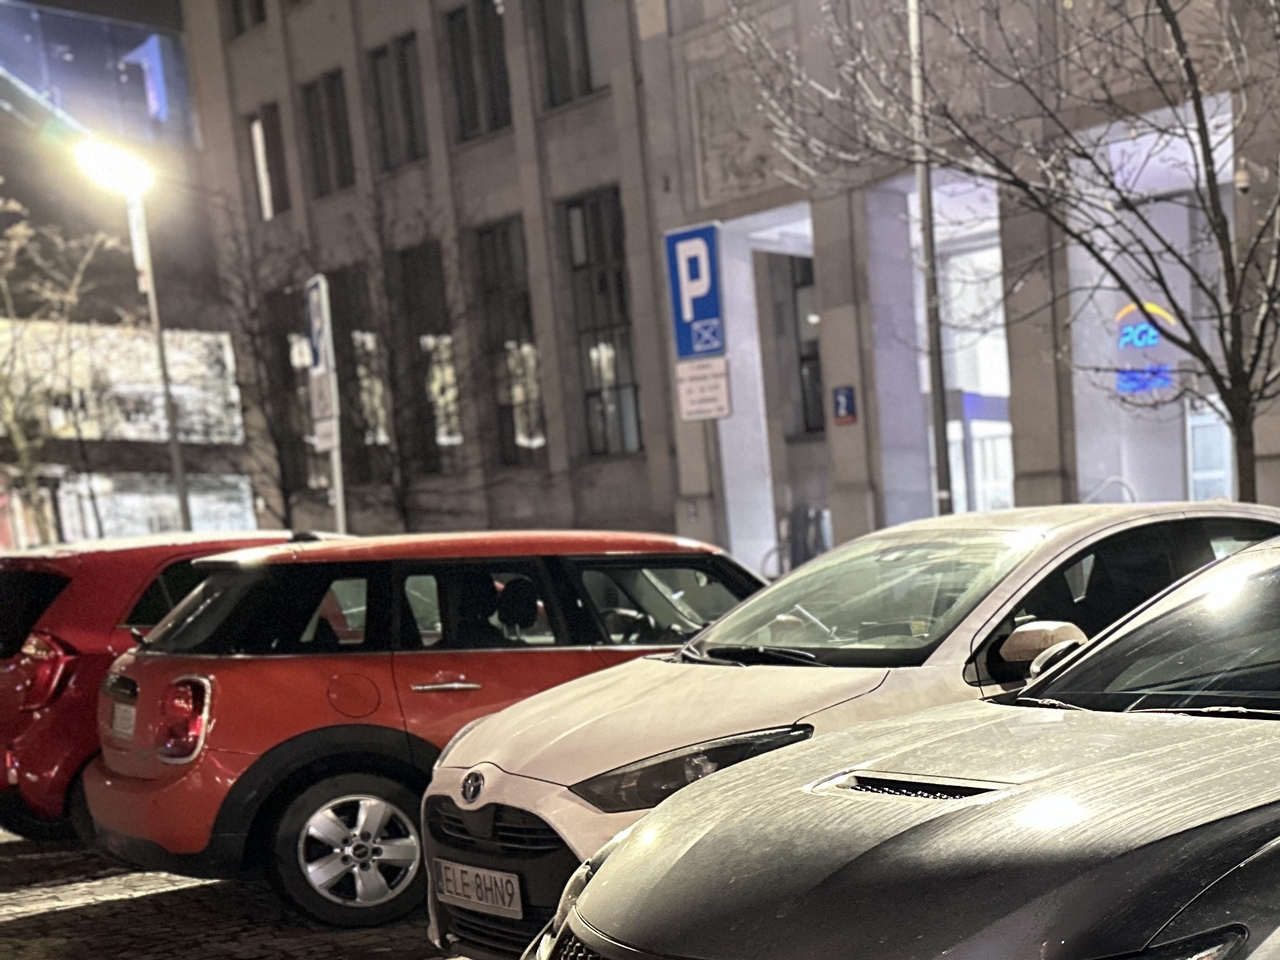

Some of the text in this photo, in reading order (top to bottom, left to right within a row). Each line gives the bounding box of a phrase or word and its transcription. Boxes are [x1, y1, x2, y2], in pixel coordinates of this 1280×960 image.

[675, 237, 711, 322] P
[1118, 322, 1159, 350] PGE
[444, 865, 514, 908] ELE 8HN9
